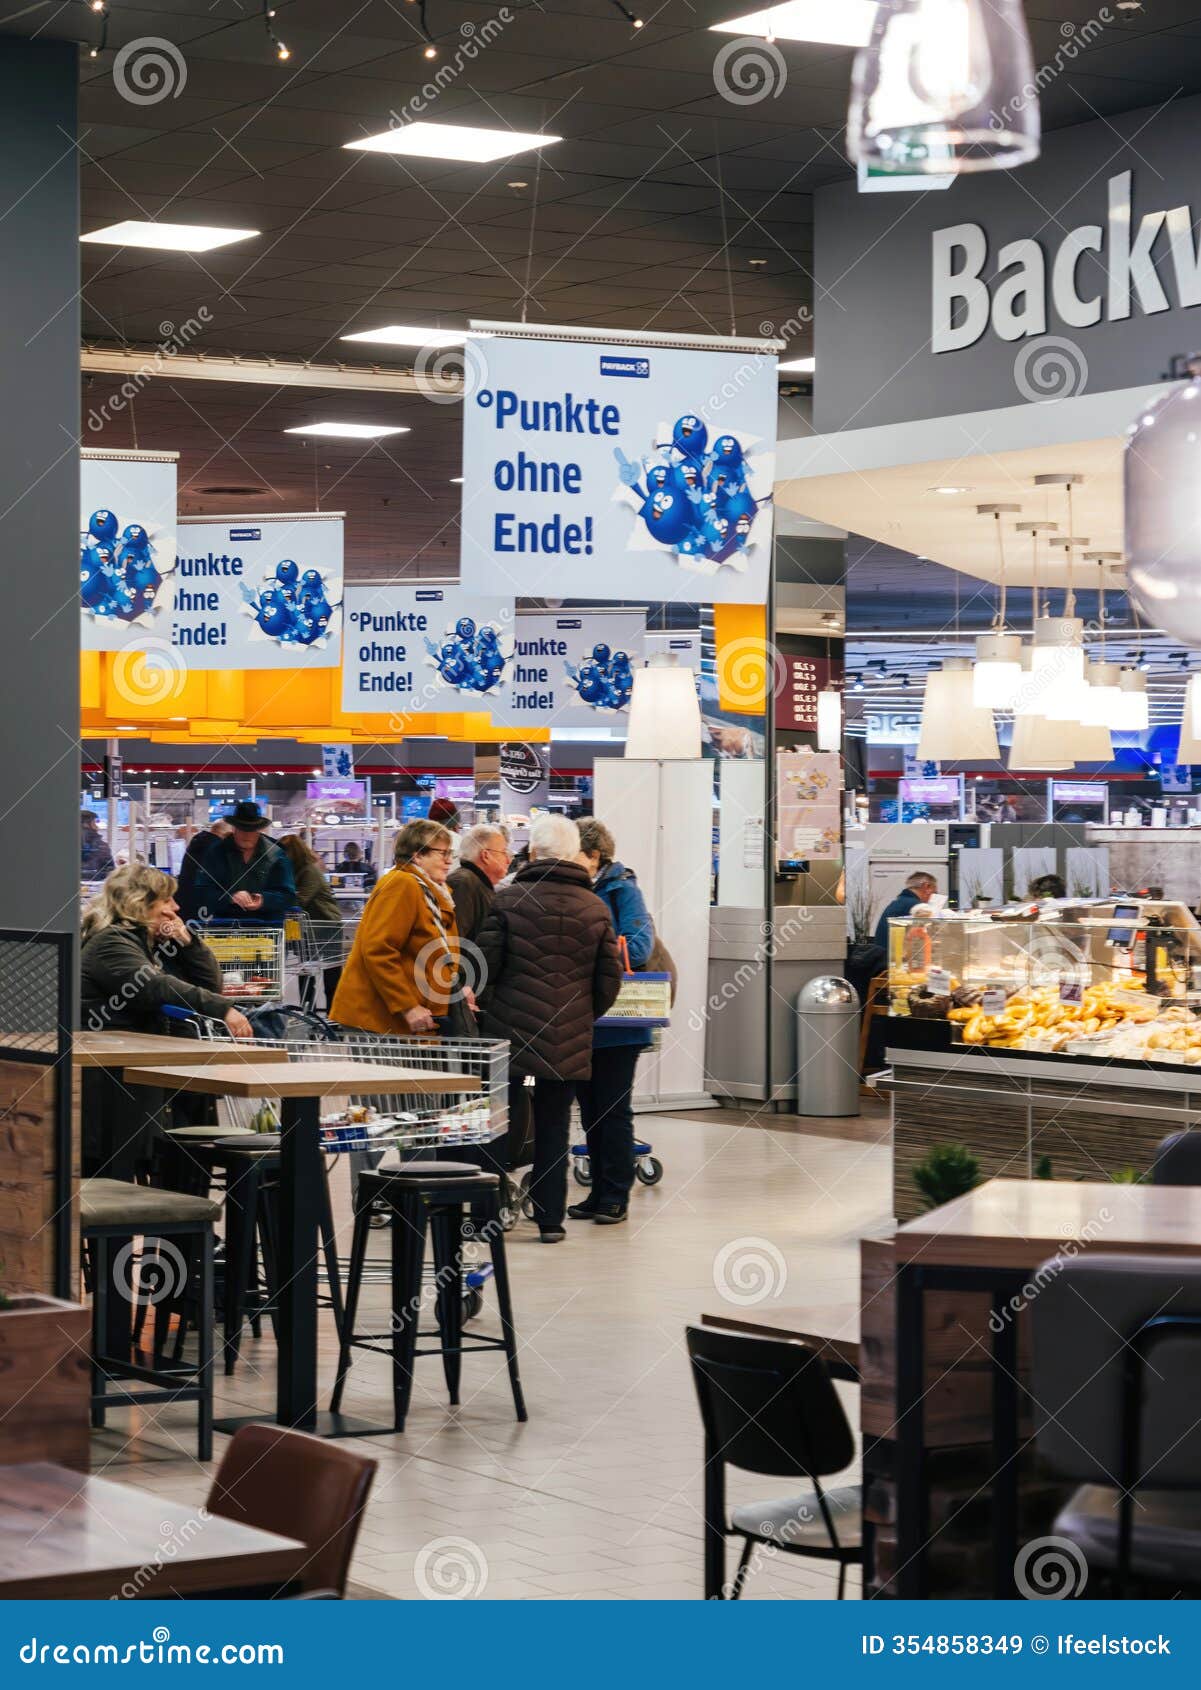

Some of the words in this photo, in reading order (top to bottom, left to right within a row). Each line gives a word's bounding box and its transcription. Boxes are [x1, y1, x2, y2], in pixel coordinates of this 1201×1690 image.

[494, 451, 581, 494] ohne
[494, 512, 594, 555] Ende!
[173, 589, 219, 611] hne
[358, 641, 407, 662] ohne
[514, 637, 568, 656] unkte
[358, 671, 413, 692] Ende!
[513, 664, 548, 683] hne
